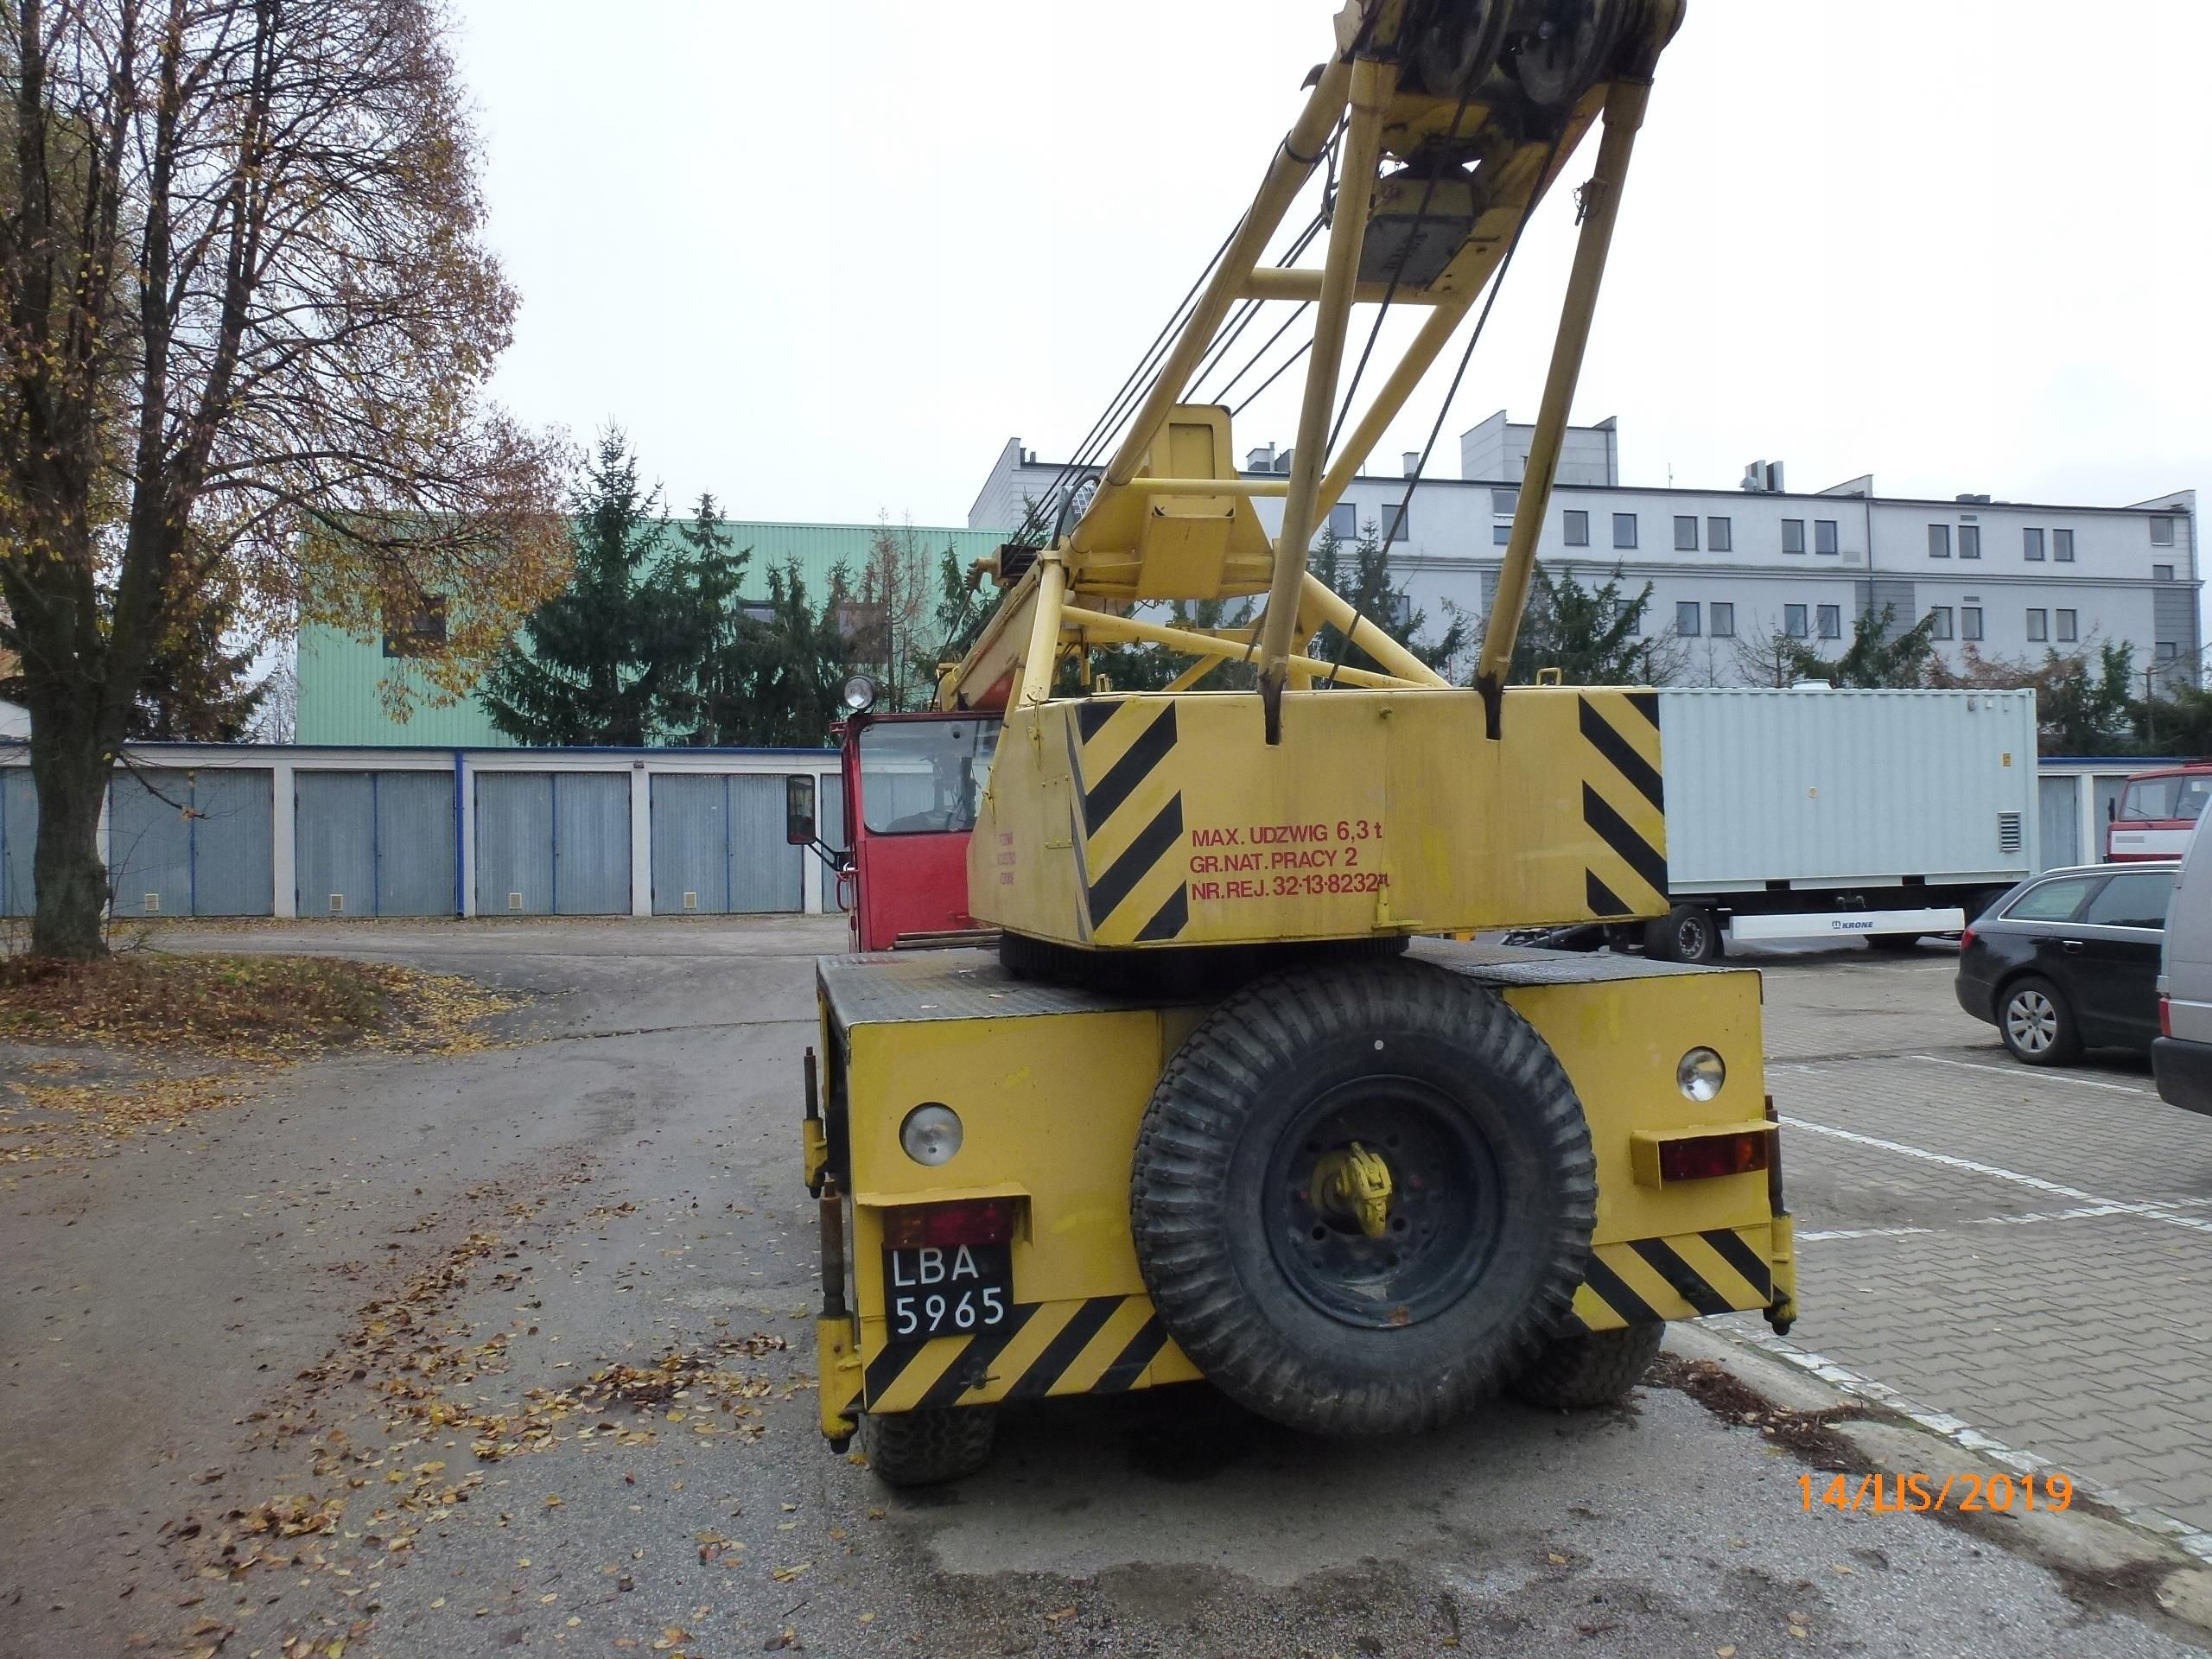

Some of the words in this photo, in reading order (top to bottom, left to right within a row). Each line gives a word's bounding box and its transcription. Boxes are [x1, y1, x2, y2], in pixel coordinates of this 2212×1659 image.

[1192, 828, 1245, 847] MAX.
[1249, 823, 1328, 844] UDZWIG
[1337, 820, 1370, 843] 6,3
[1373, 822, 1382, 839] t
[1344, 847, 1358, 867] 2
[893, 1244, 979, 1287] LBA
[896, 1287, 1004, 1334] 5965
